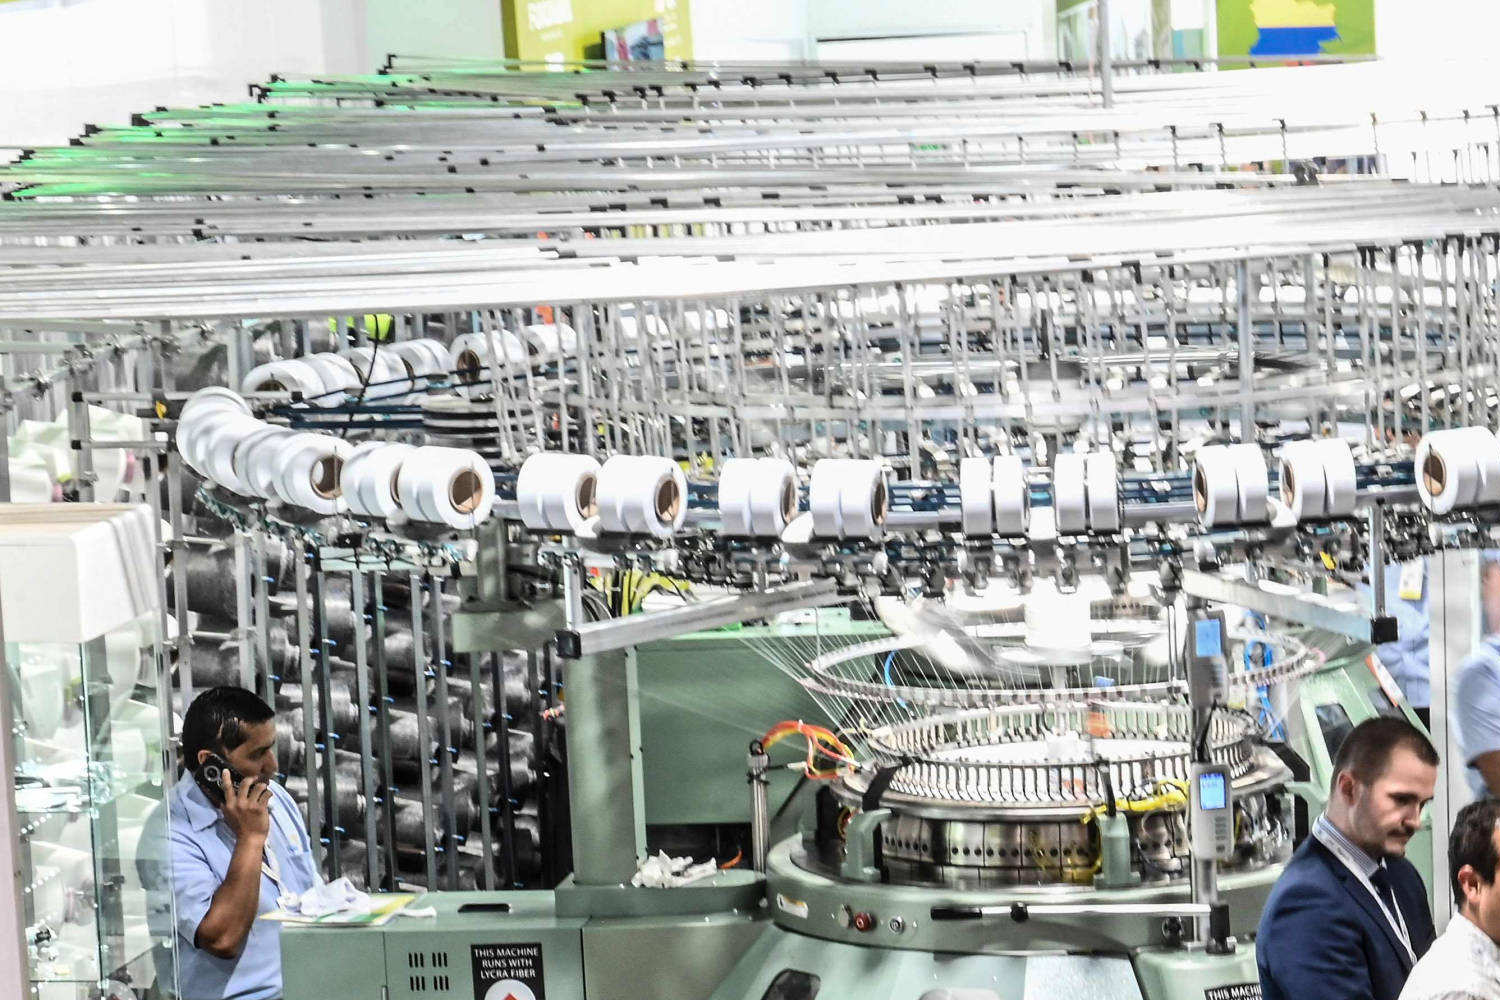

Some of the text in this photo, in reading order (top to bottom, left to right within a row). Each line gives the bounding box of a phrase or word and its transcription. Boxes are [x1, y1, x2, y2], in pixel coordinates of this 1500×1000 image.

[475, 947, 538, 957] THIS MACHINE
[482, 958, 532, 967] RUNS WITH
[480, 968, 536, 979] LYCRA FIBER
[1208, 989, 1229, 1000] THIS
